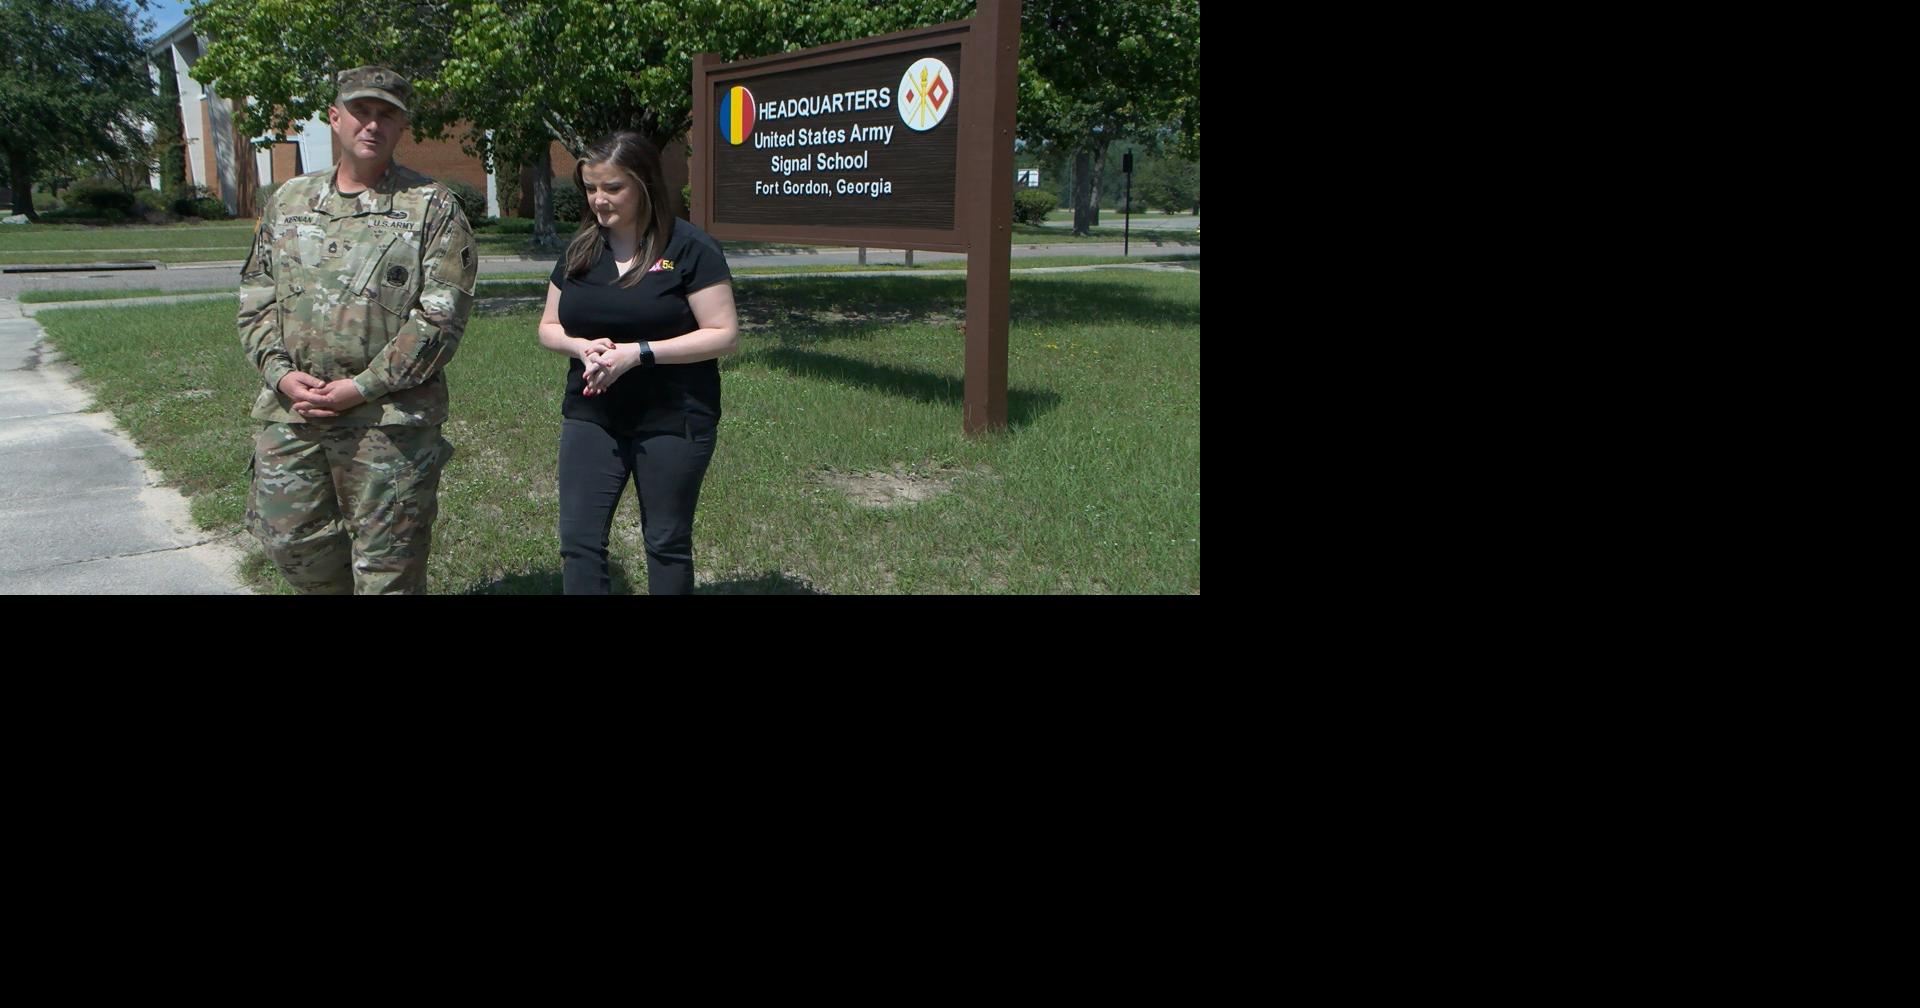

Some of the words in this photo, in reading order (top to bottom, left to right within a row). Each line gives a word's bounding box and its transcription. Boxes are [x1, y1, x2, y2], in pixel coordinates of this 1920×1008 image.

[759, 87, 891, 120] HEADQUARTERS
[754, 130, 795, 149] United
[798, 127, 846, 146] States
[850, 123, 894, 145] Army
[771, 153, 812, 175] Signal
[816, 150, 868, 171] School
[755, 180, 780, 195] Fort
[783, 179, 832, 197] Gordon,
[836, 178, 892, 197] Georgia
